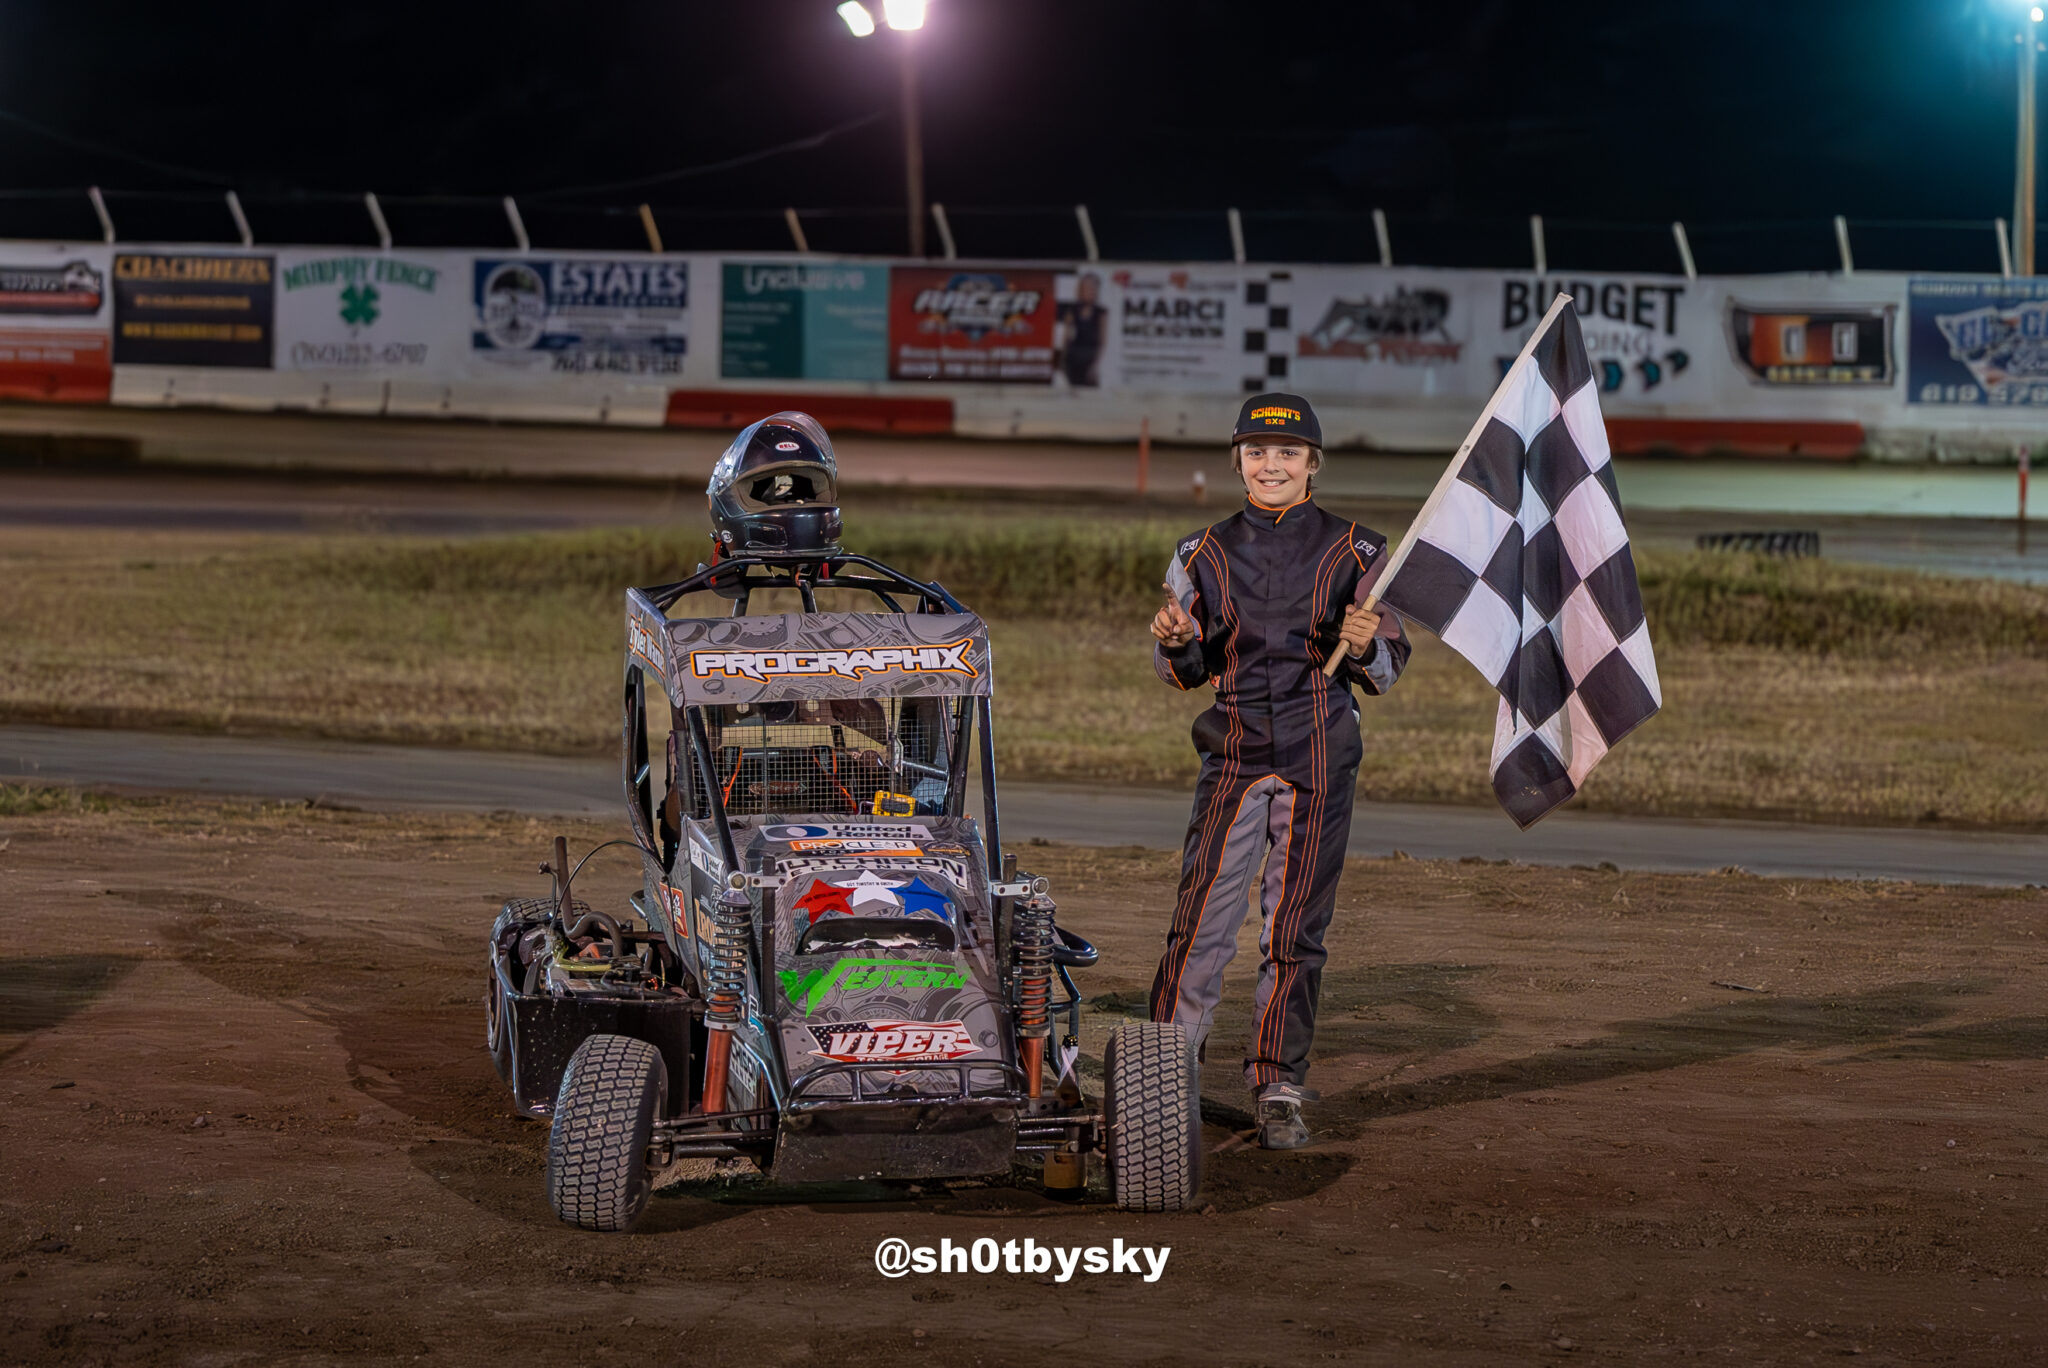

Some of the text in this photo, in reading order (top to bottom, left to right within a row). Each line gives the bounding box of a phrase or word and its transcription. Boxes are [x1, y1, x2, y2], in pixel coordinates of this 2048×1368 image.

[552, 262, 684, 295] ESTATES
[1123, 298, 1225, 321] MARCI
[1503, 280, 1686, 336] BUDGET
[693, 640, 977, 683] PROGRAPHIX
[832, 825, 912, 833] United
[835, 831, 924, 839] Rentals
[790, 864, 967, 888] ECHANICAL
[778, 957, 971, 1018] WESTERN
[829, 1031, 959, 1056] VIPER
